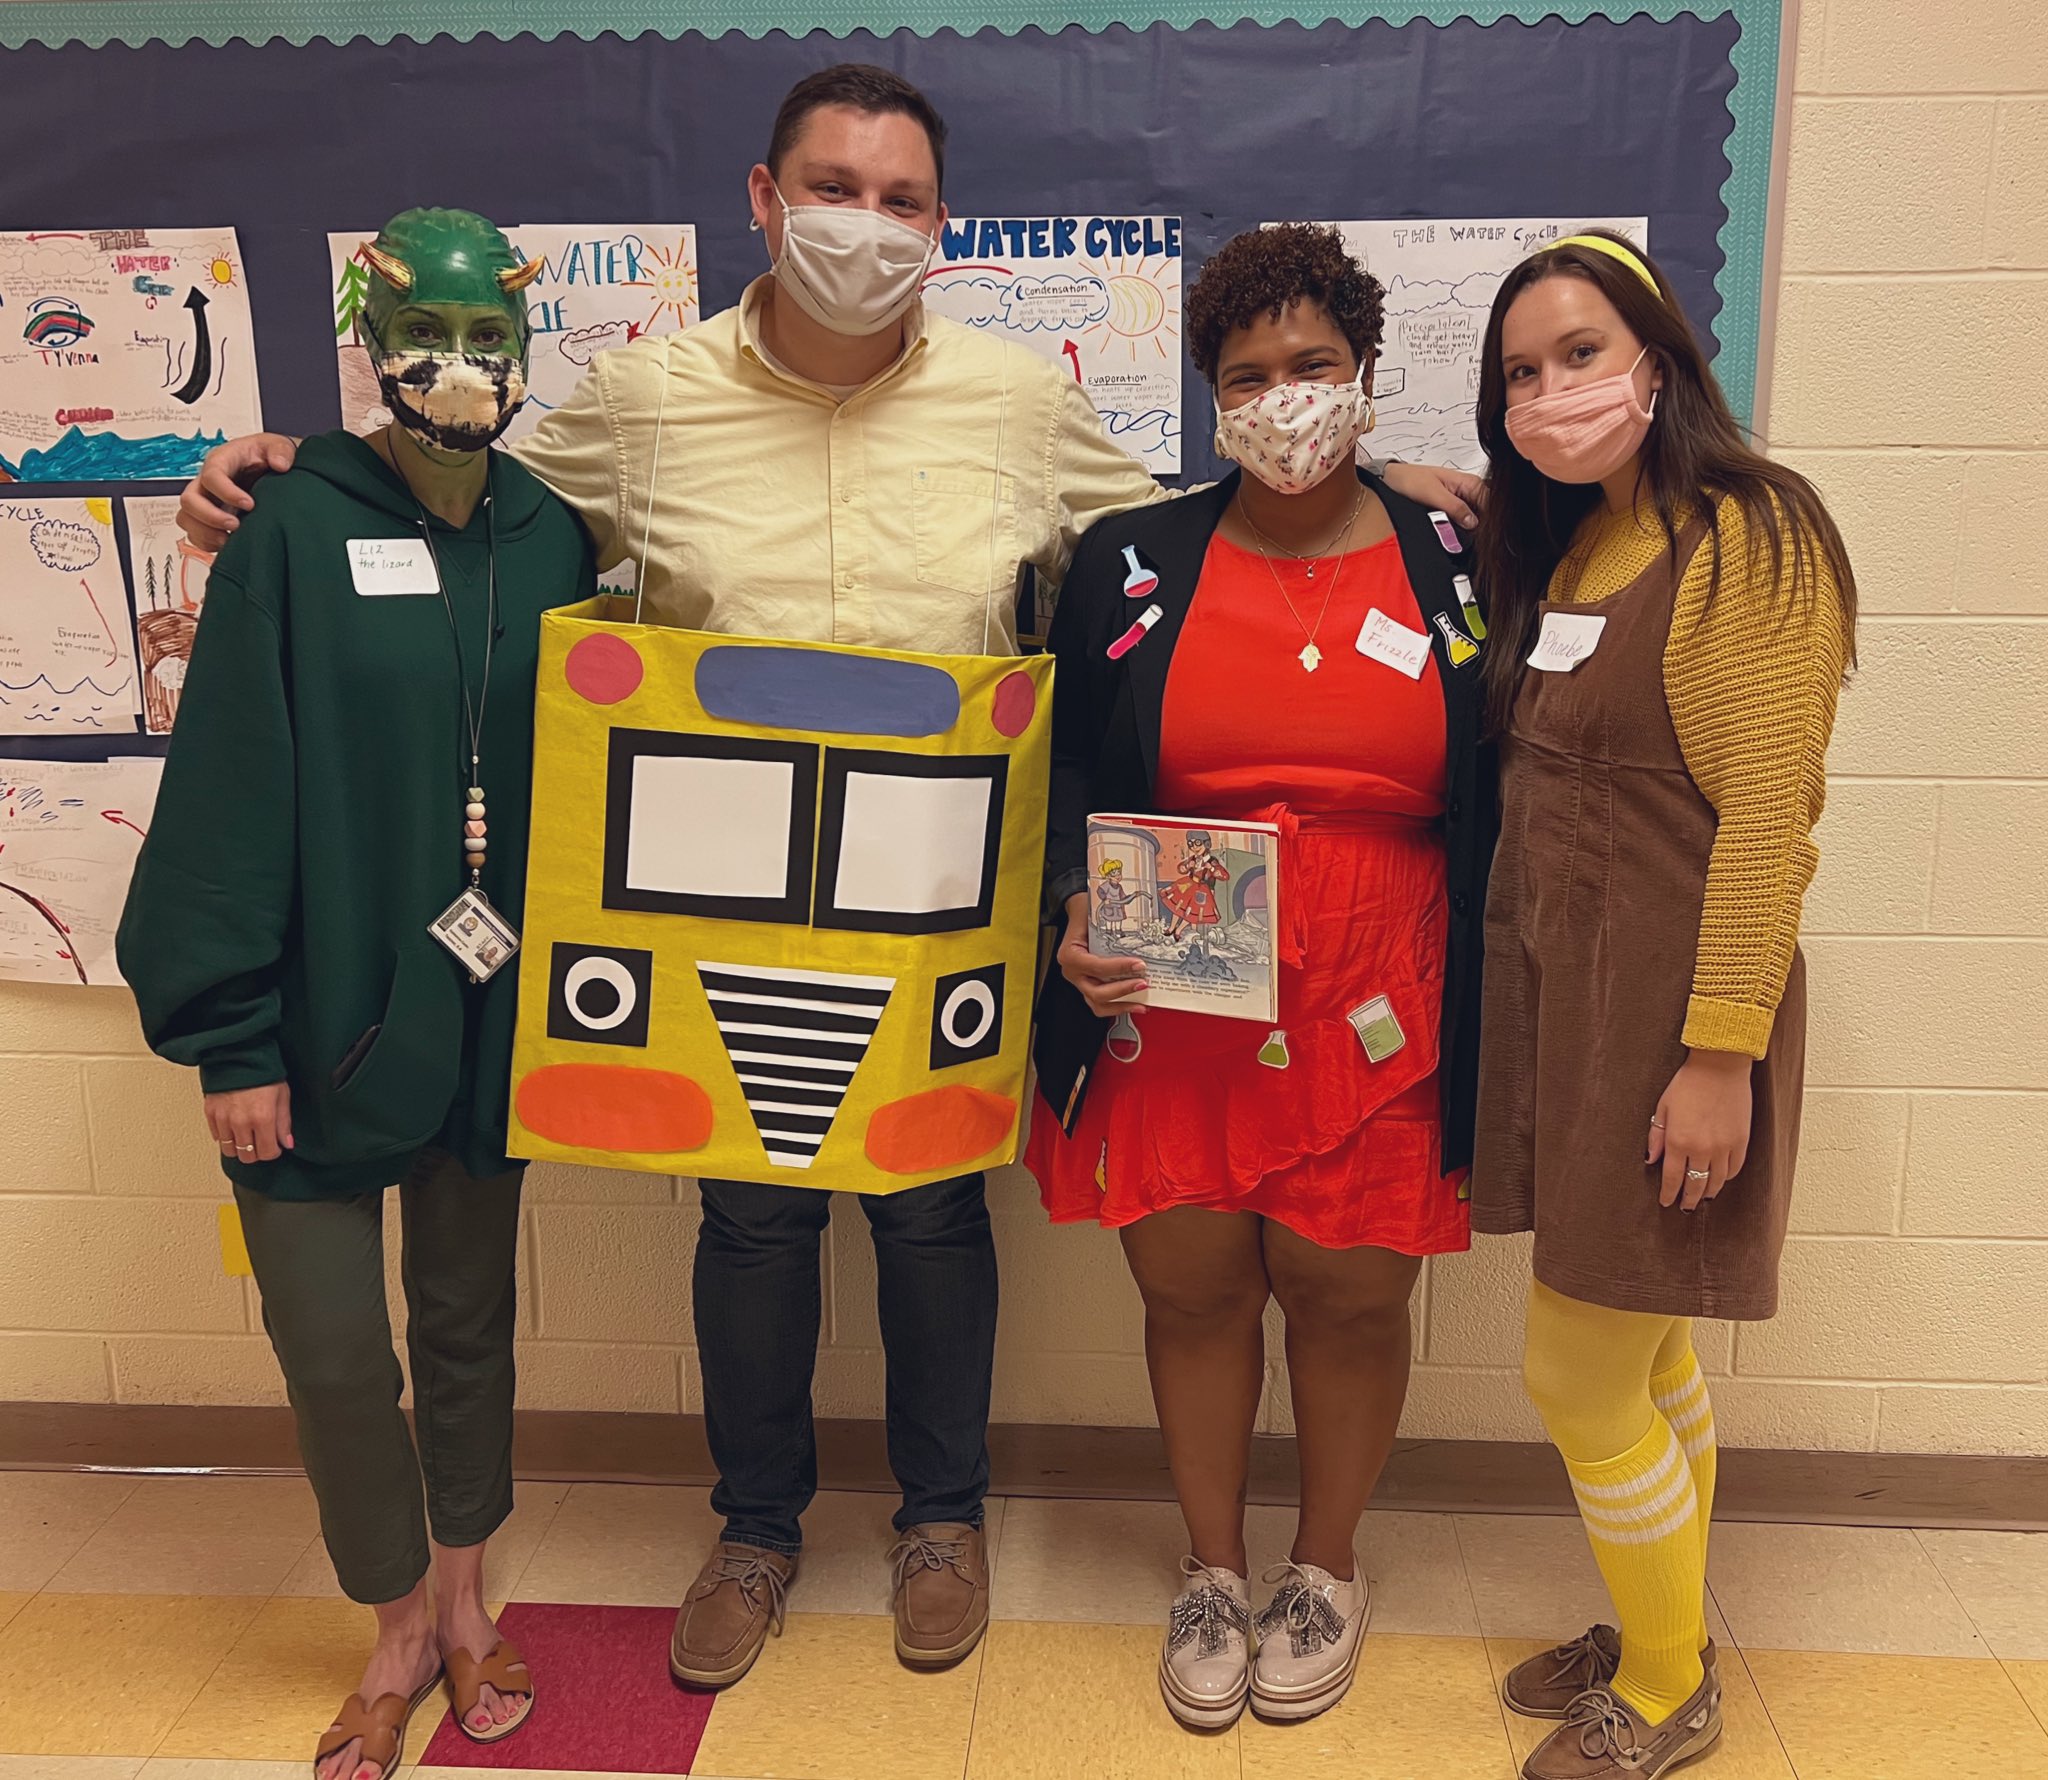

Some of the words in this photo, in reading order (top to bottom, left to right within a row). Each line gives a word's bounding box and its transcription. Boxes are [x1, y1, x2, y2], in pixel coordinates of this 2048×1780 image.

[89, 229, 150, 251] THE
[941, 217, 1078, 261] WATER
[1085, 217, 1182, 259] CYCLE
[1393, 225, 1435, 248] THE
[1449, 226, 1507, 242] WATER
[116, 255, 170, 274] WATER
[512, 234, 647, 288] WATER
[1024, 282, 1089, 297] Condensation
[1087, 373, 1148, 387] Evaporation
[357, 558, 376, 569] the
[381, 559, 413, 569] lizard
[1367, 631, 1418, 665] Frizzle
[1539, 629, 1584, 658] Phoebe
